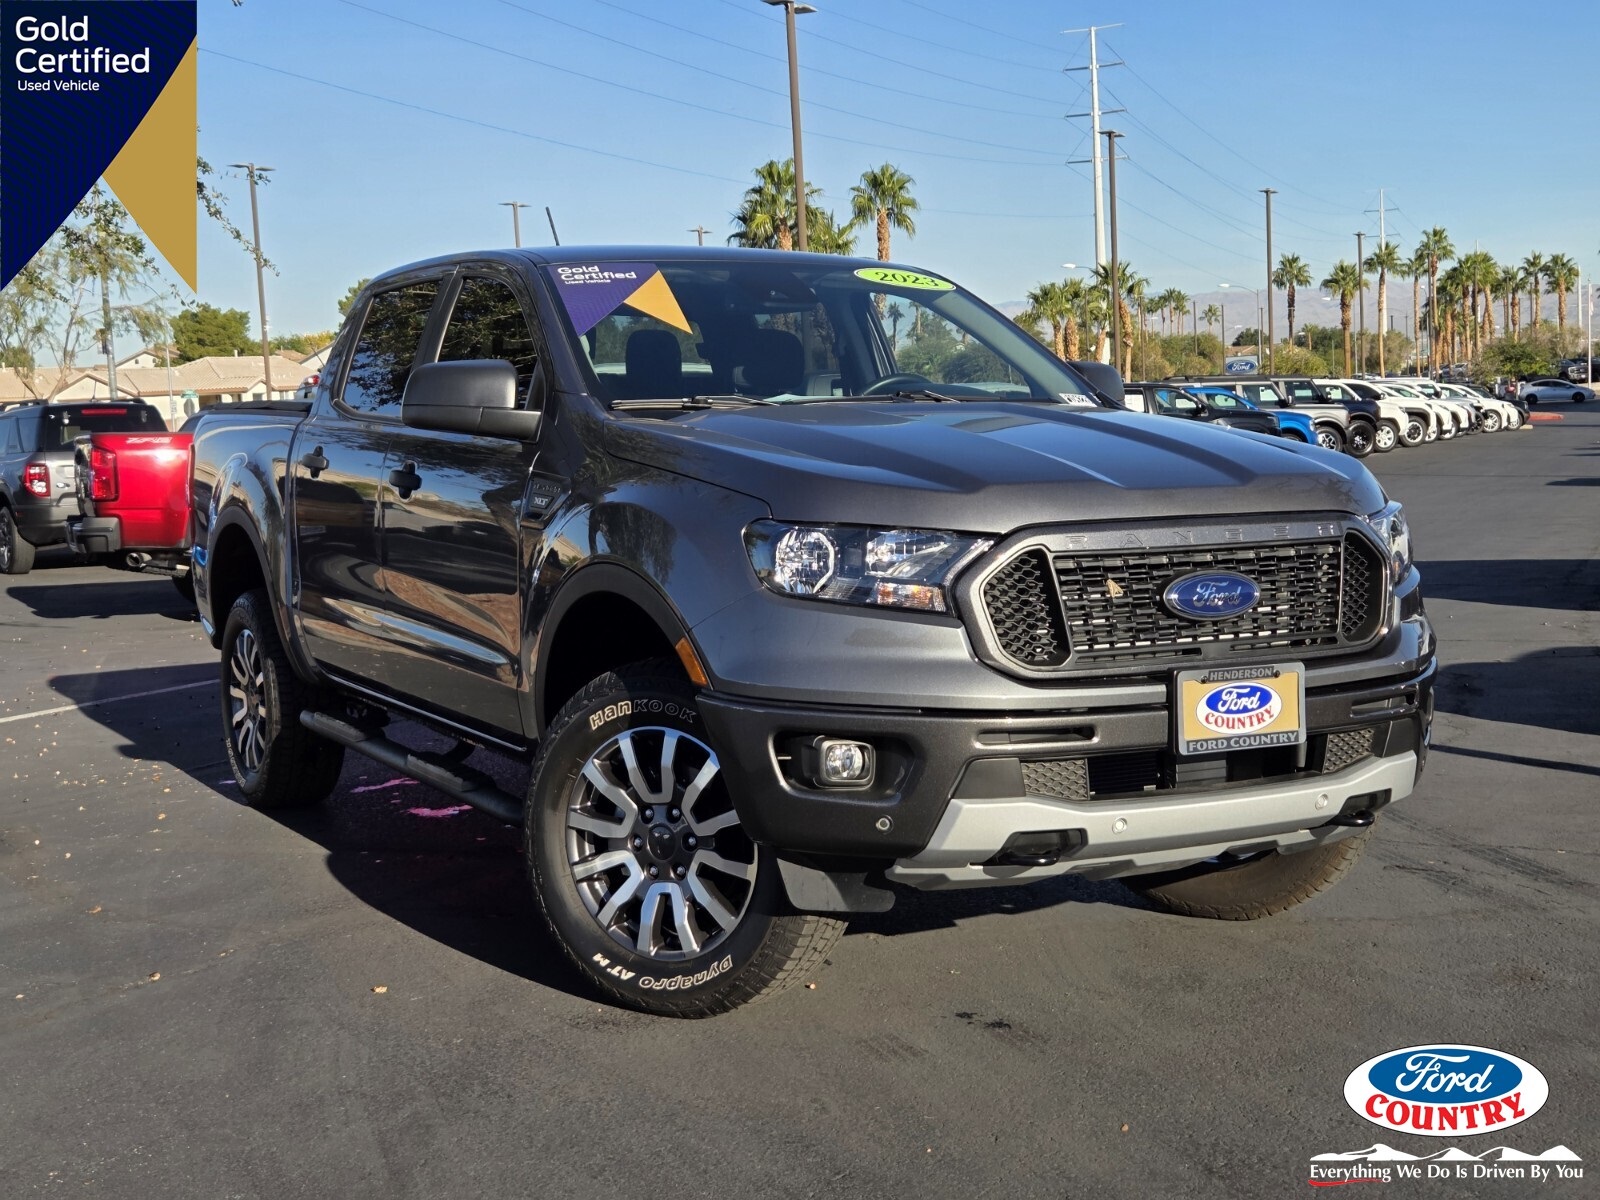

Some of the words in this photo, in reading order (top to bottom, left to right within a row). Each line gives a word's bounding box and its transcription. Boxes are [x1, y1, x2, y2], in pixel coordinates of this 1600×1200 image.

[557, 265, 600, 274] Gold
[561, 271, 637, 281] Certified
[874, 271, 939, 287] 2023
[1231, 362, 1251, 371] Ford
[533, 496, 549, 506] XLT
[1193, 580, 1241, 608] Ford
[1209, 667, 1273, 681] HENDERSON
[1217, 687, 1261, 712] Ford
[1204, 705, 1275, 730] COUNTRY
[1189, 739, 1228, 752] FORD
[1230, 731, 1298, 747] COUNTRY
